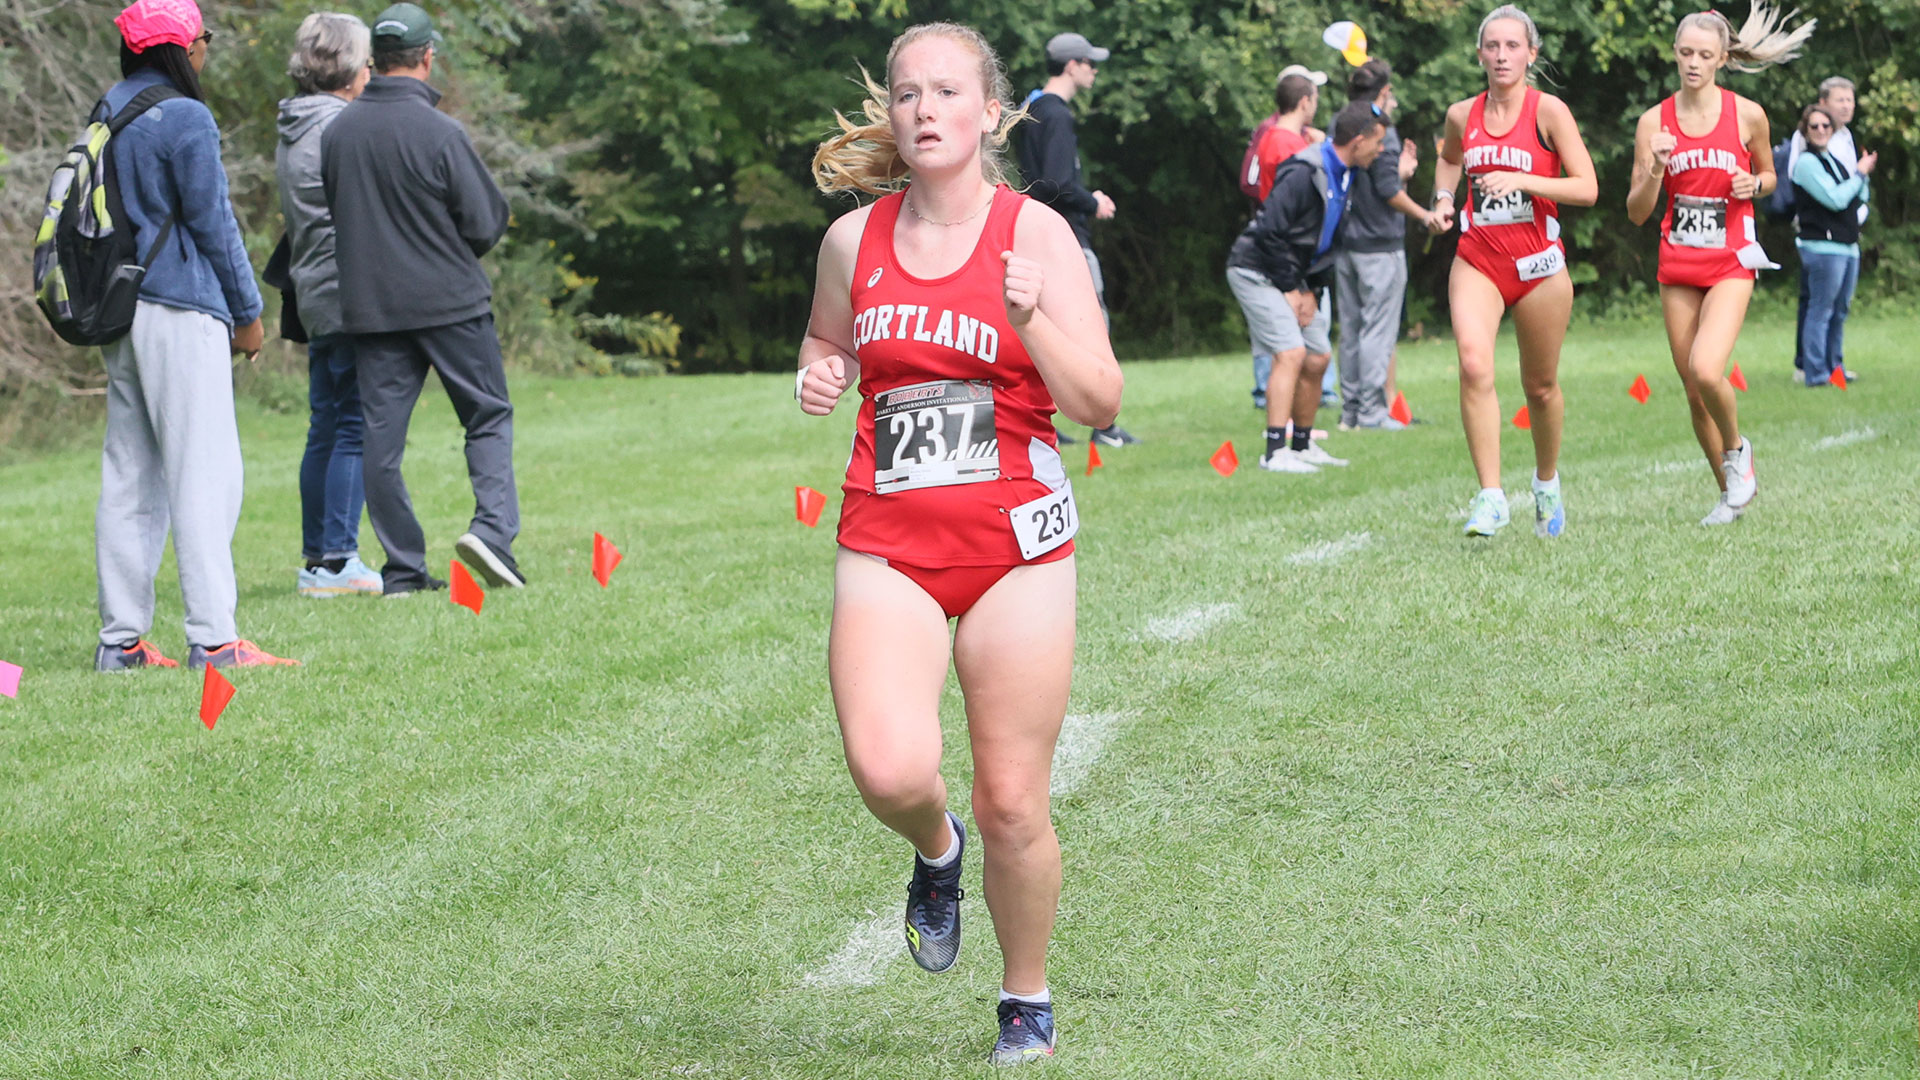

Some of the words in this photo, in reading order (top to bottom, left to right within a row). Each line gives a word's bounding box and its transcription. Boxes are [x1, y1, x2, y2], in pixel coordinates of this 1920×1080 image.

[1676, 207, 1717, 237] 235
[1529, 253, 1557, 274] 239
[853, 304, 999, 364] CORTLAND
[887, 385, 946, 406] ROBERTS
[897, 401, 926, 411] ANDERSON
[926, 396, 969, 406] INVITATIONAL
[890, 404, 974, 470] 237
[1032, 495, 1070, 543] 237
